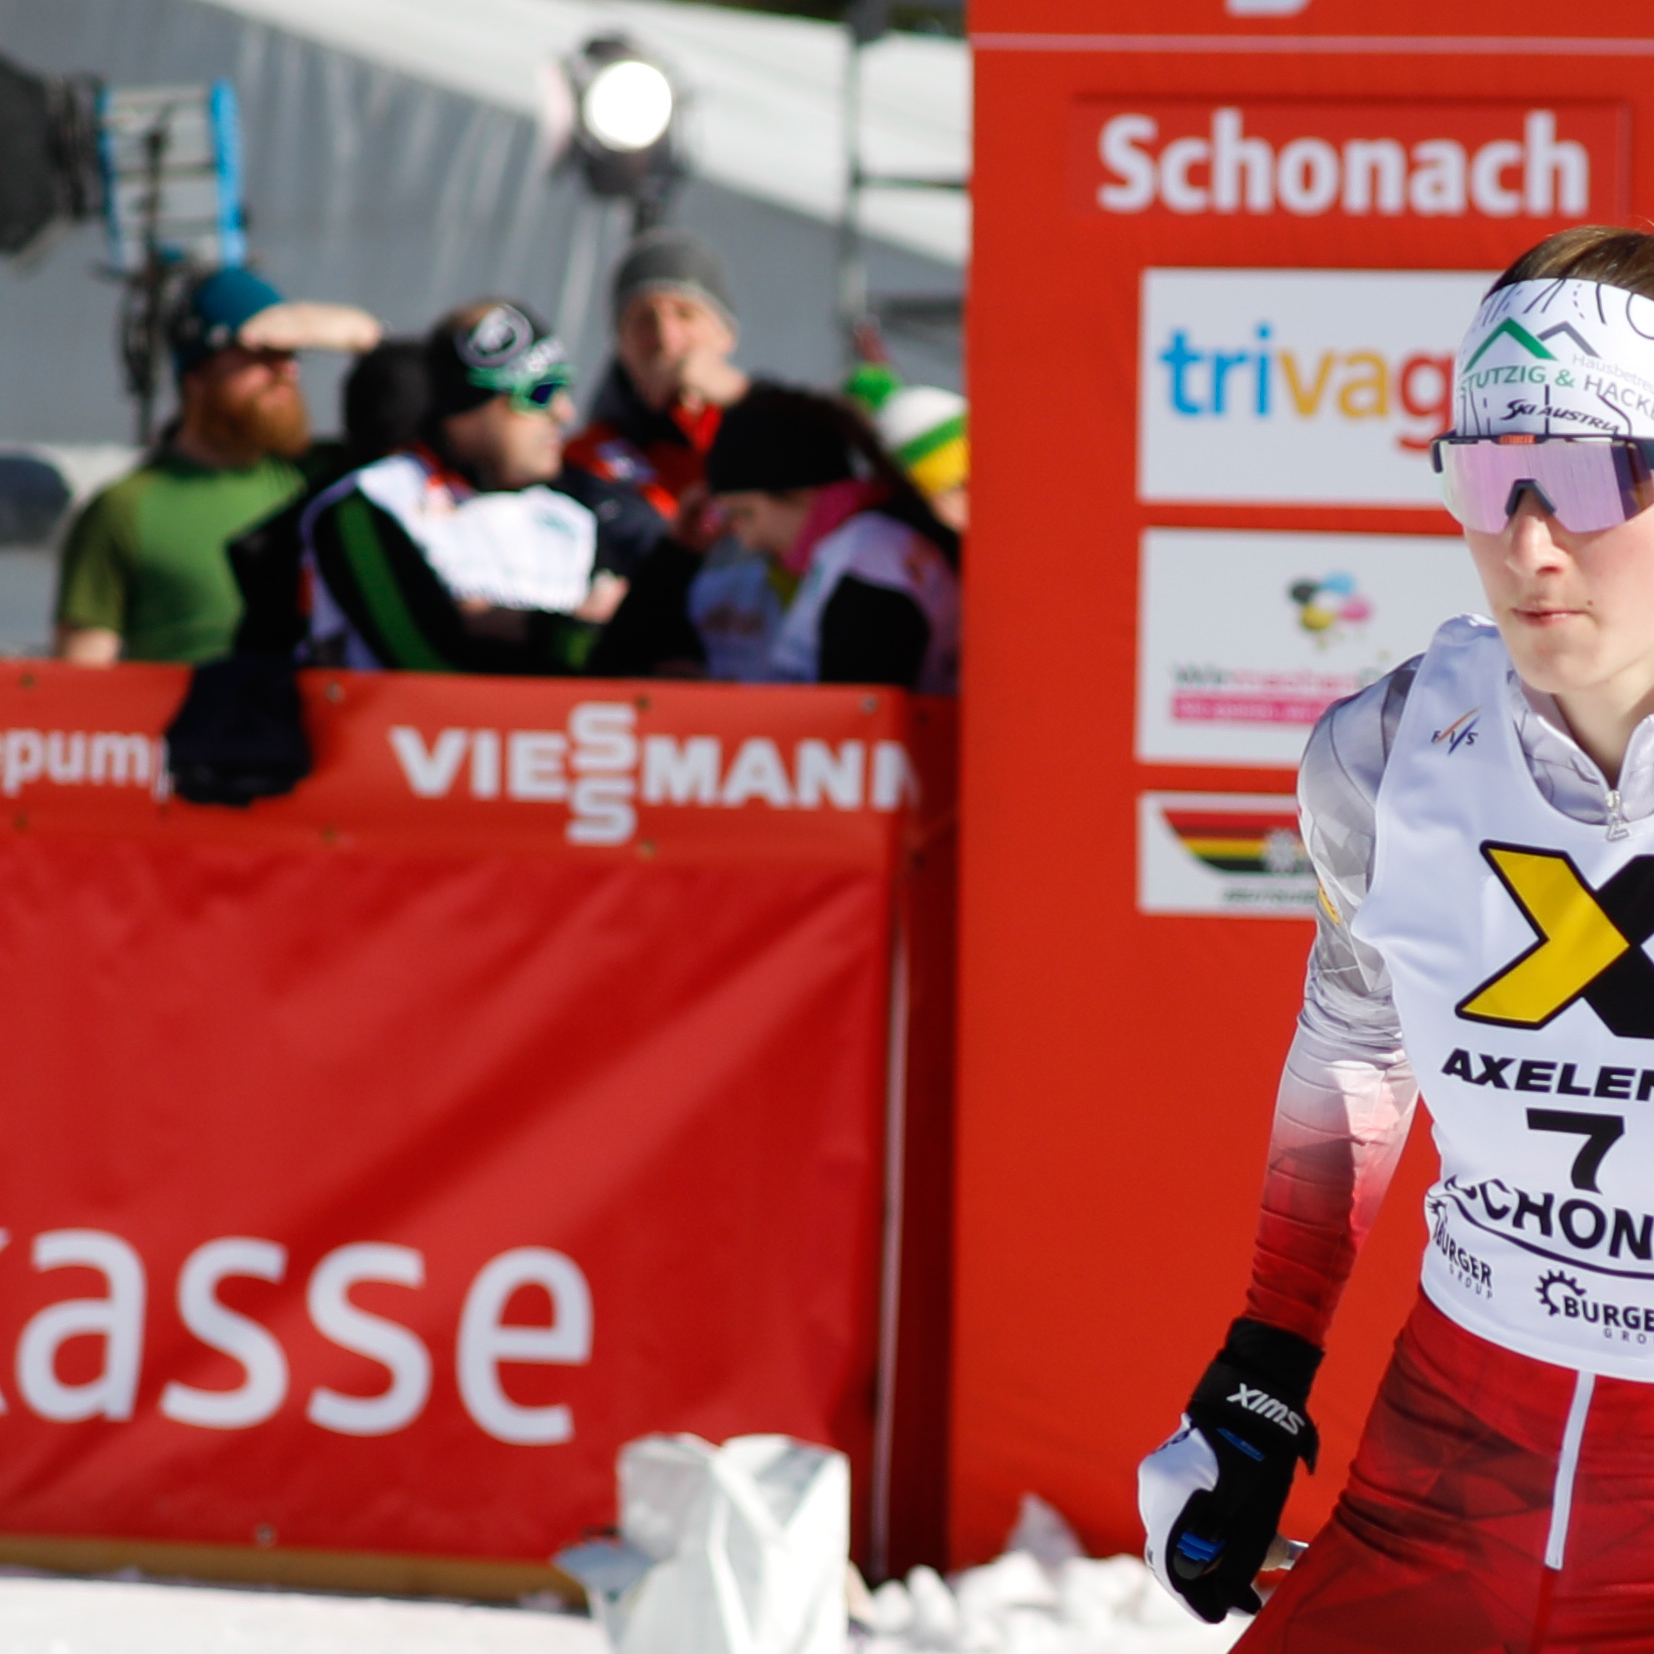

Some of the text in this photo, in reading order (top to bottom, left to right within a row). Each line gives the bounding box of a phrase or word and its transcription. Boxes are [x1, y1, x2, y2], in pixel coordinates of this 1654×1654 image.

[1097, 107, 1589, 216] Schonach
[1158, 324, 1455, 452] trivag
[1499, 399, 1620, 435] SKI AUSTRIA
[1555, 369, 1575, 388] &
[1526, 1107, 1625, 1194] 7
